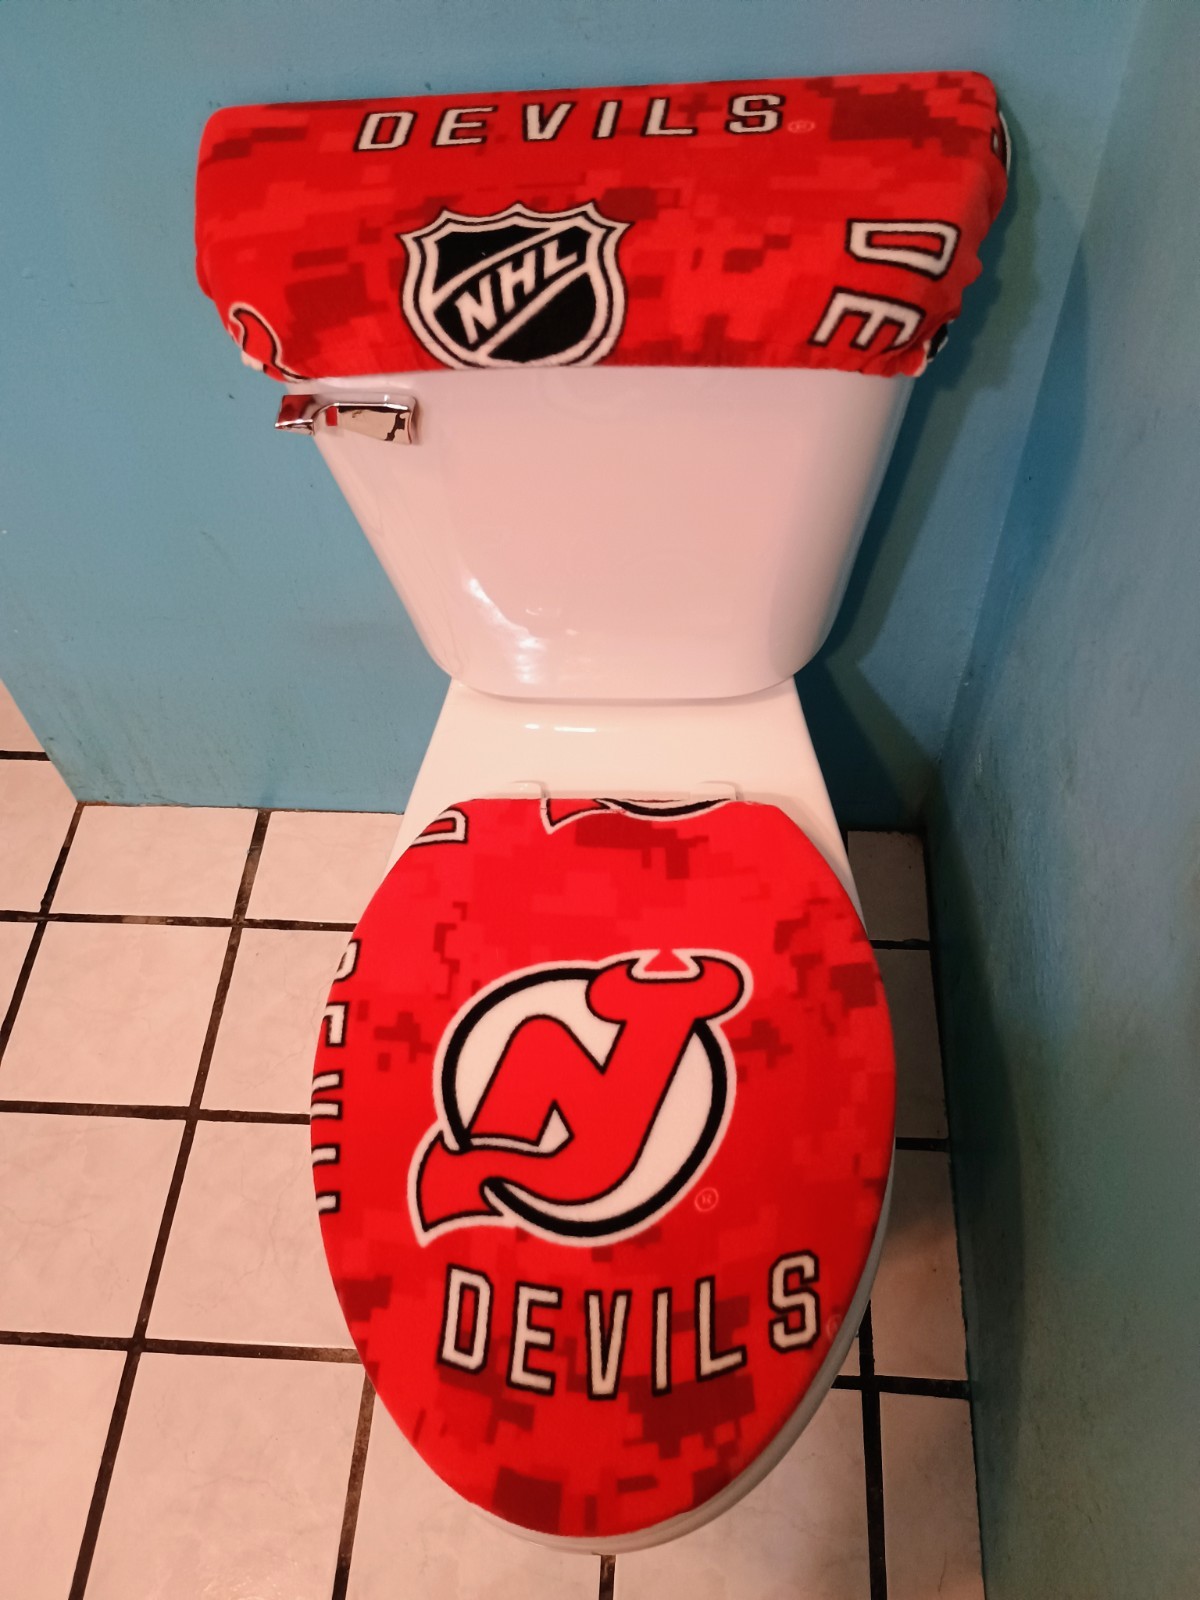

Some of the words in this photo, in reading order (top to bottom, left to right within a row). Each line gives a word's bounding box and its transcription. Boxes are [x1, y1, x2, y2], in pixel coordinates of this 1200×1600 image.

[354, 93, 786, 152] DEVILS
[454, 238, 578, 345] NHL
[437, 1249, 820, 1400] DEVILS
